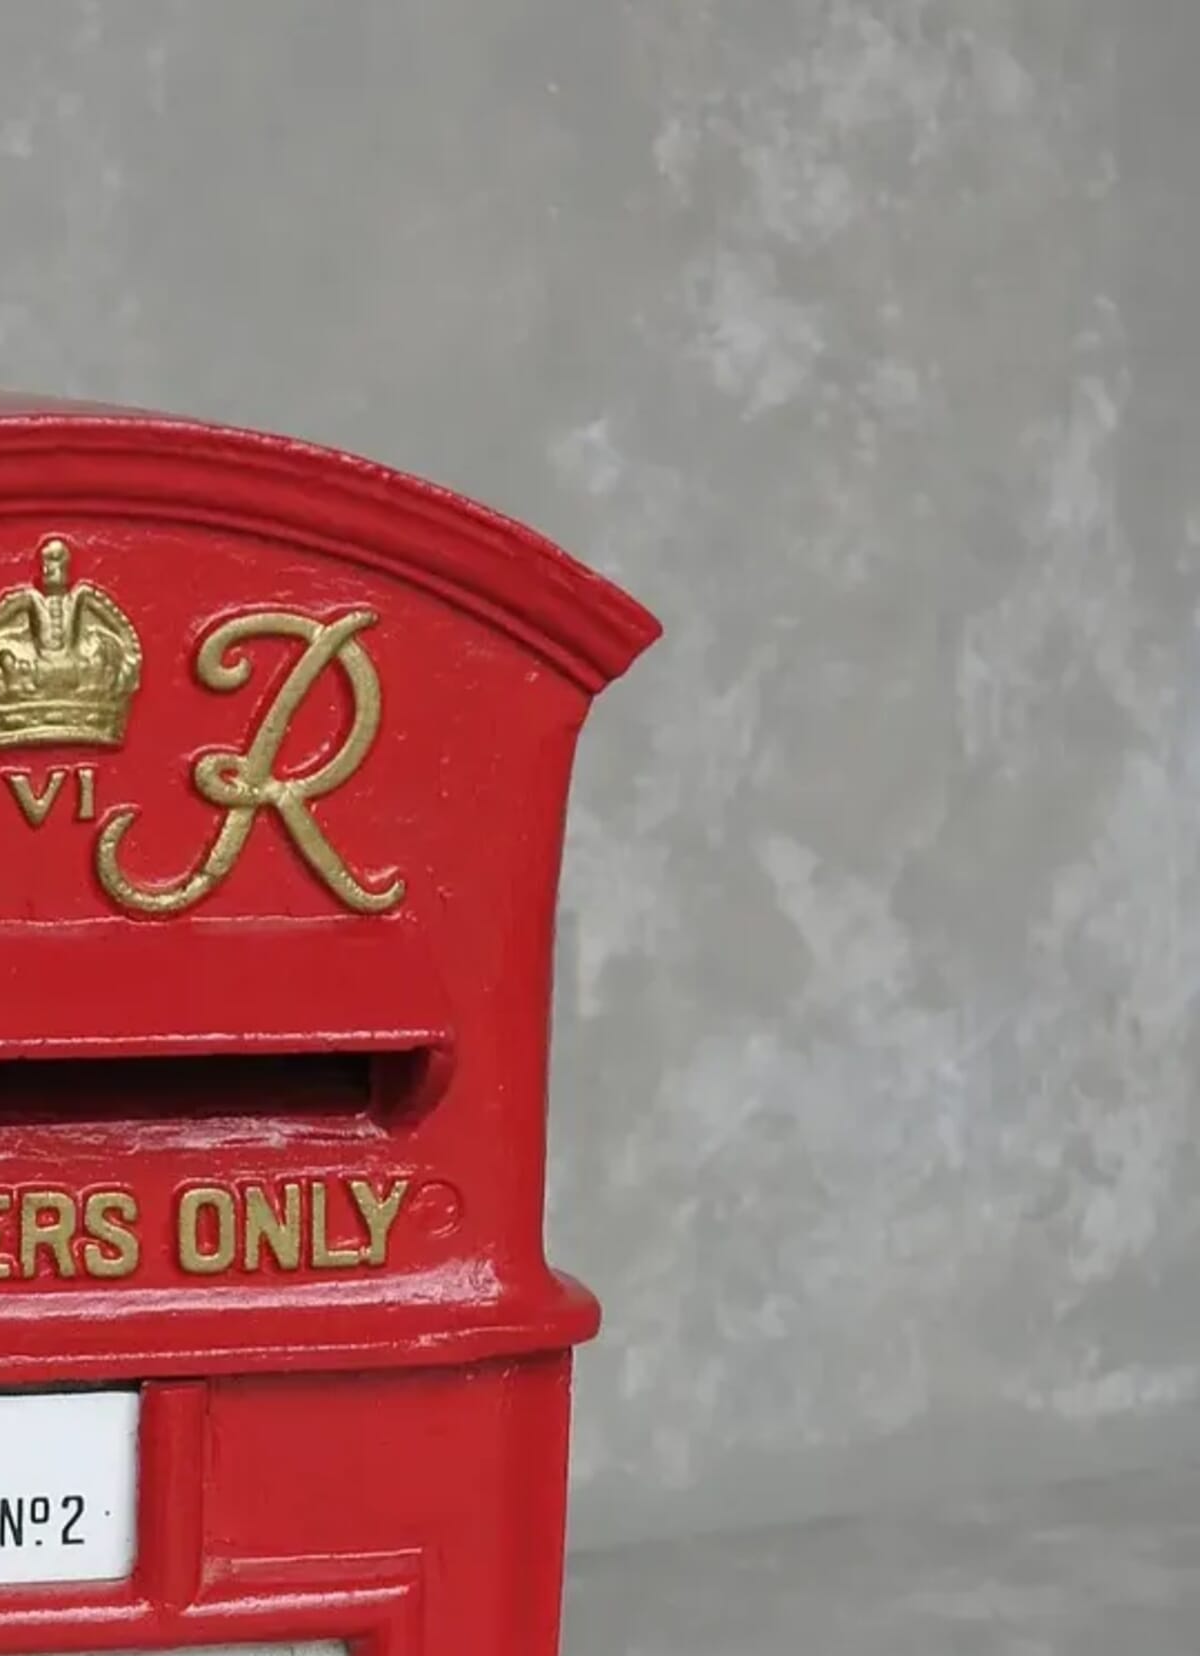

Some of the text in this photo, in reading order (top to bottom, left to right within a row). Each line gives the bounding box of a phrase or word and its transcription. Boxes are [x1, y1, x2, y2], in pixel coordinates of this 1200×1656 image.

[11, 767, 95, 825] VI
[99, 609, 406, 914] R
[178, 1180, 411, 1275] ONLY
